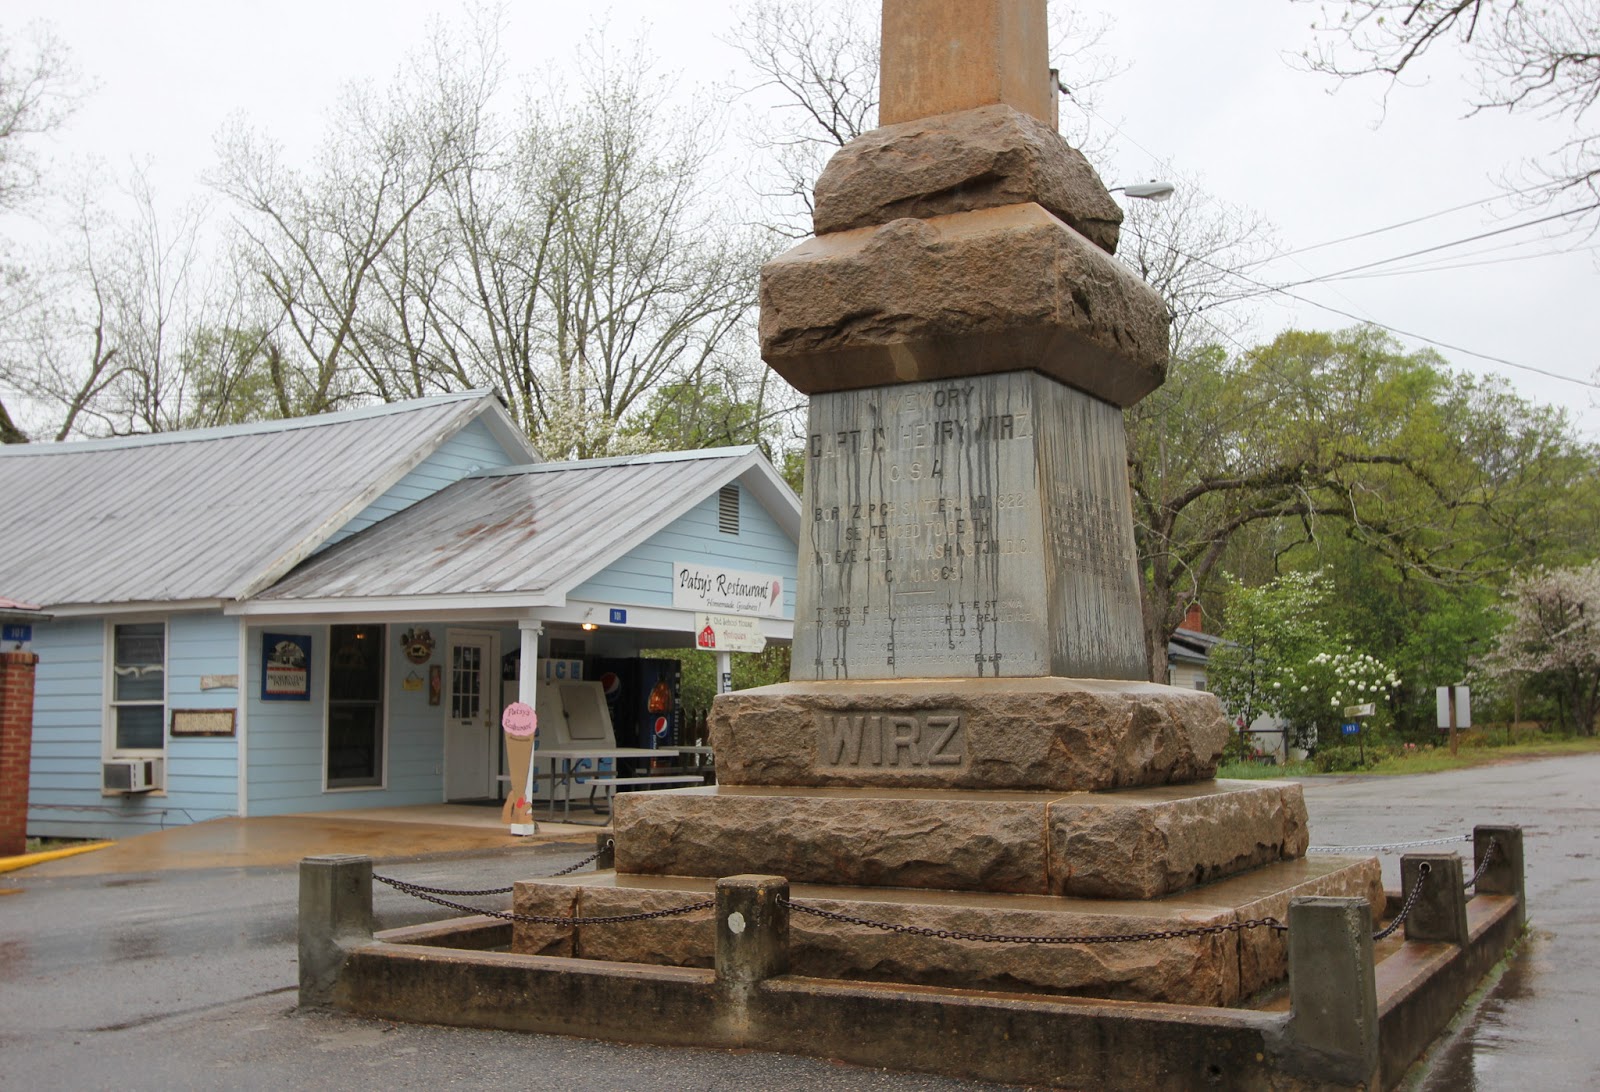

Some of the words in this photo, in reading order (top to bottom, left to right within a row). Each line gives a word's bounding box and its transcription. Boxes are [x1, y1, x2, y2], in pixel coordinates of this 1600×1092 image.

[888, 386, 975, 415] MEMORY
[810, 424, 890, 459] CAPTAIN
[901, 418, 968, 451] HENRY
[846, 522, 920, 541] SENTENCED
[949, 516, 990, 536] DEATH
[680, 569, 712, 598] Patsy's
[717, 574, 769, 599] Restaurant
[546, 661, 580, 679] ICE
[823, 715, 962, 765] WIRZ
